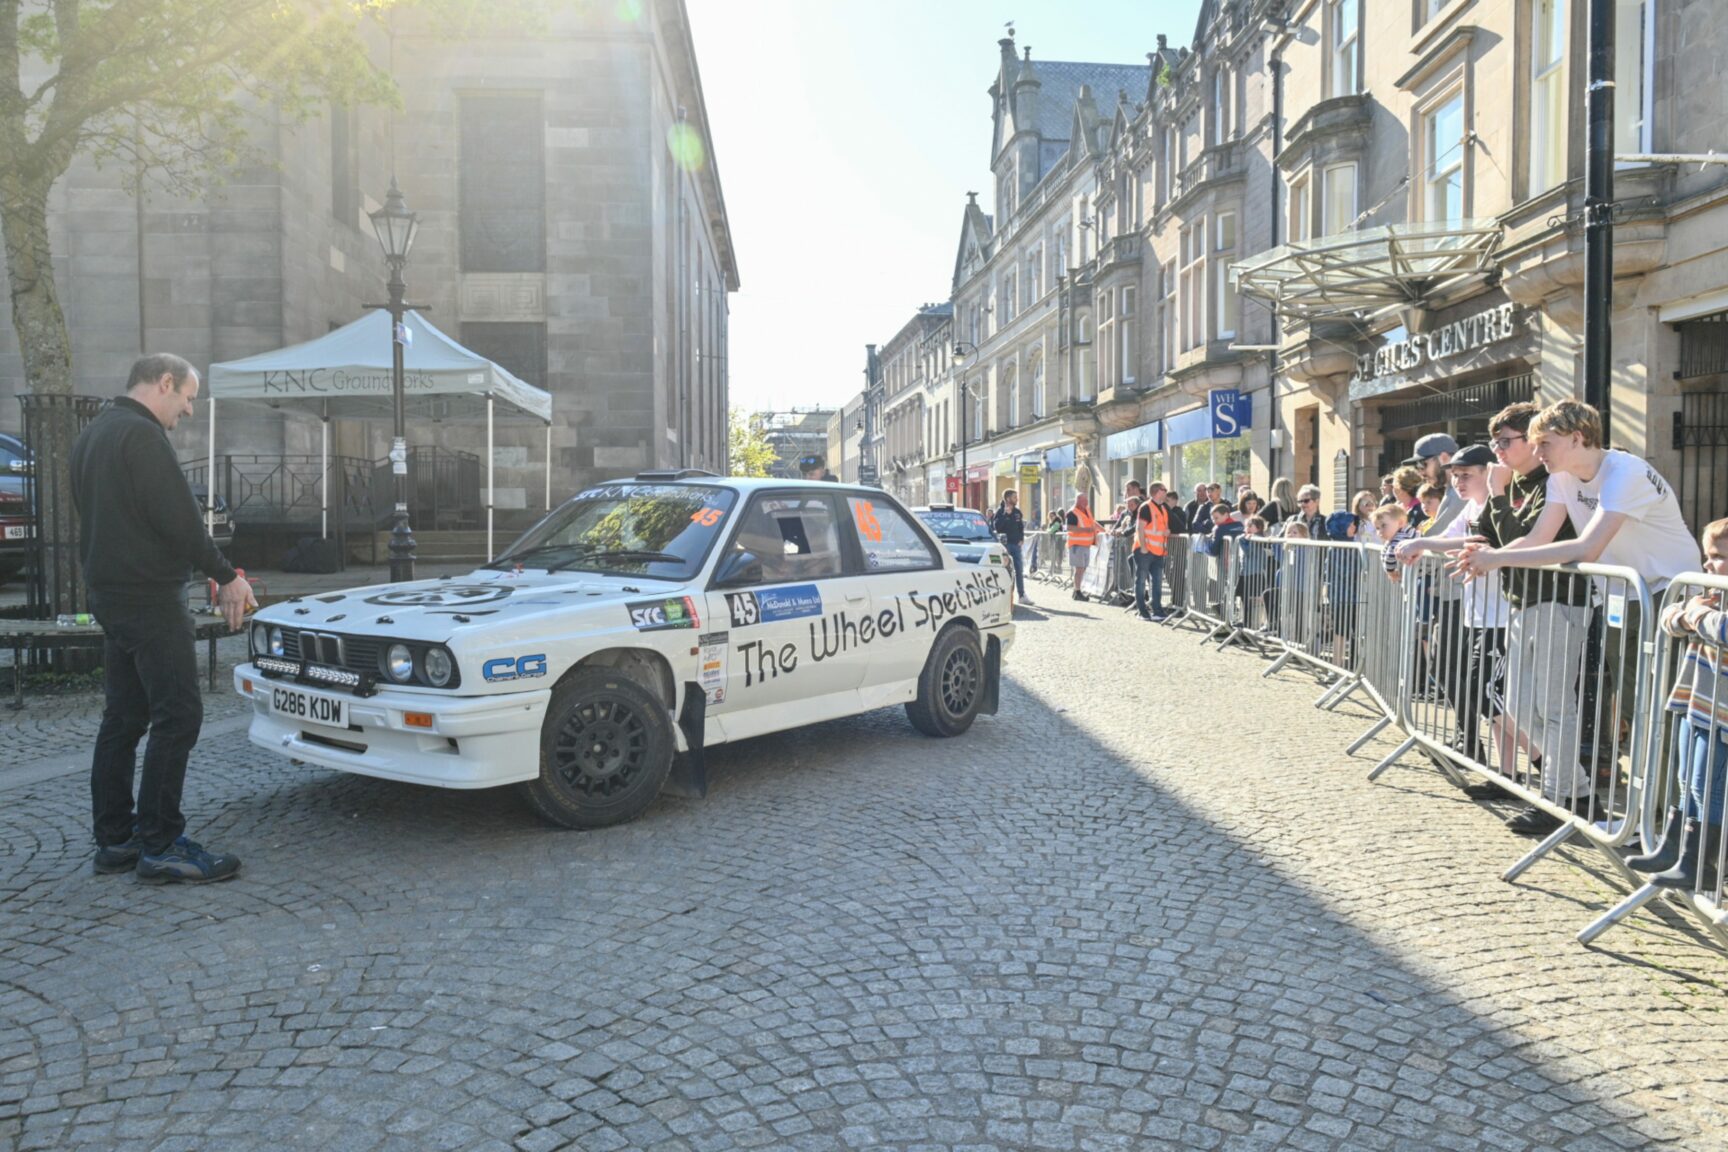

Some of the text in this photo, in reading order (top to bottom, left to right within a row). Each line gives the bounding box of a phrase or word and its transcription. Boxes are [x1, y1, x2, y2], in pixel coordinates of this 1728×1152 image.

[1373, 334, 1422, 378] GILES
[1427, 301, 1514, 361] CENTRE
[263, 367, 434, 393] KNC Groundorks
[1215, 393, 1236, 403] WH
[1215, 403, 1237, 435] S
[690, 507, 724, 527] 45
[854, 499, 883, 543] 45
[733, 593, 756, 625] 45
[737, 569, 1006, 687] The Wheel Specialist
[483, 653, 547, 681] CG
[273, 687, 341, 723] G286 KDW
